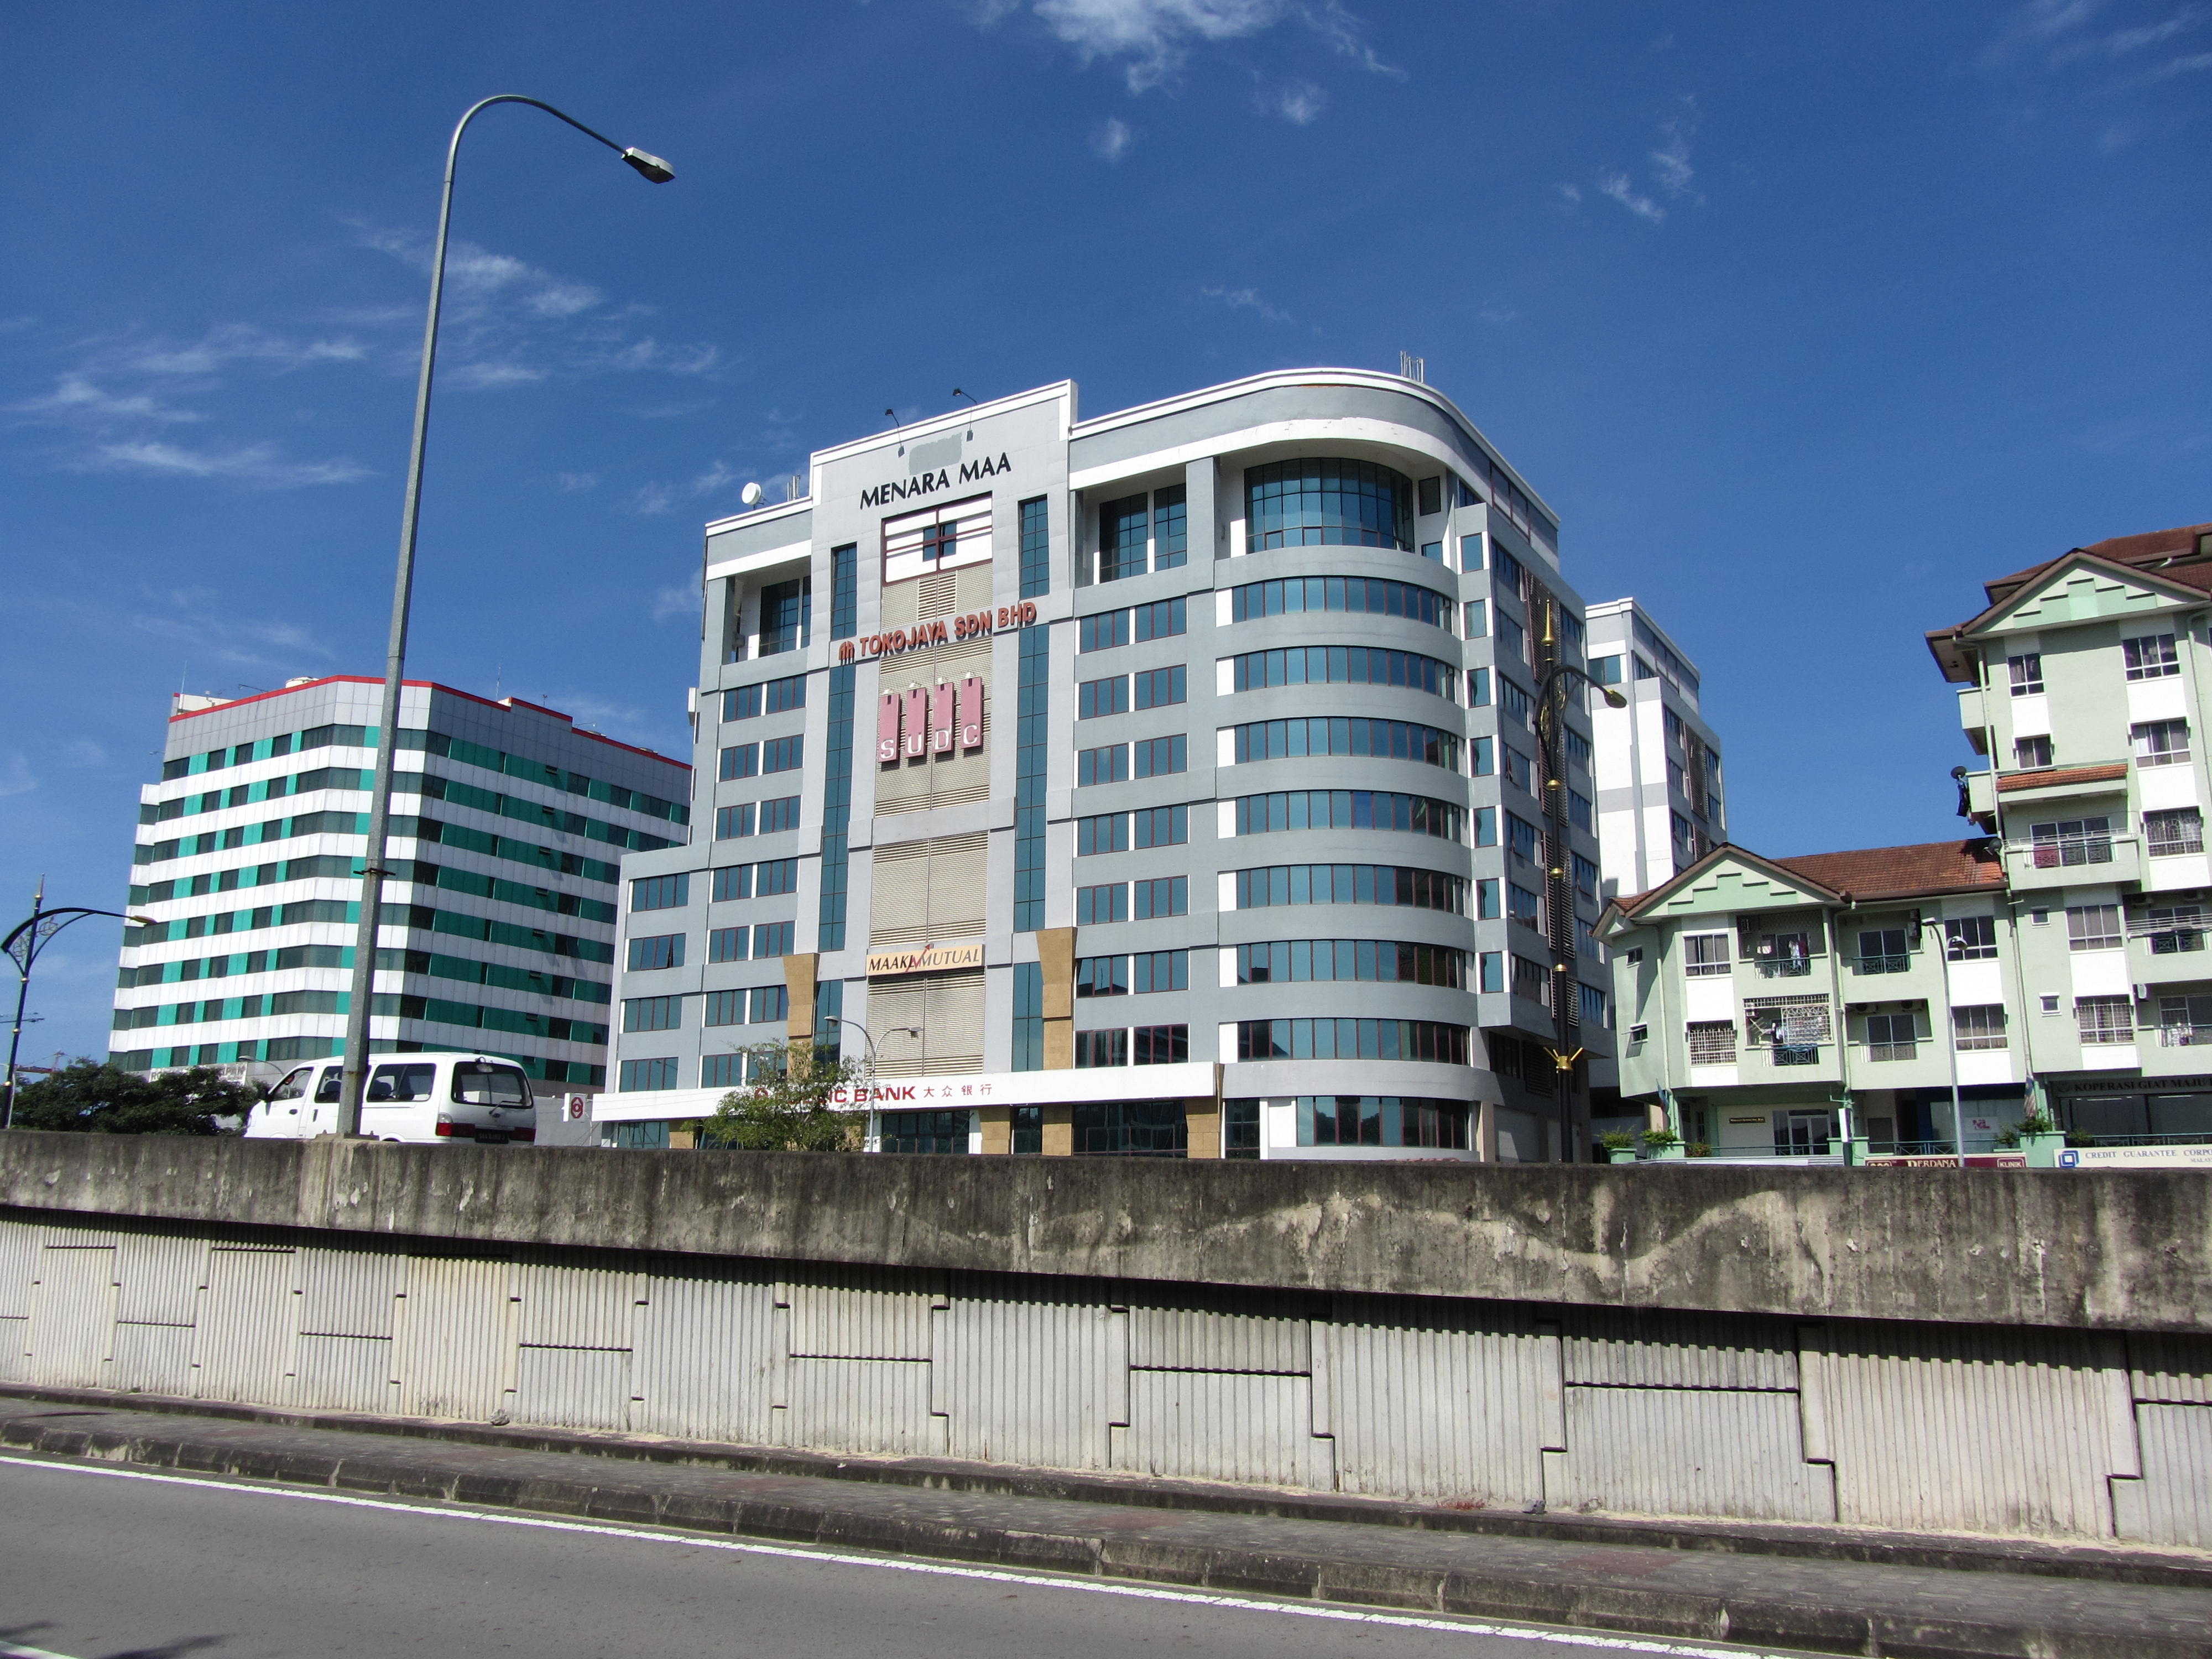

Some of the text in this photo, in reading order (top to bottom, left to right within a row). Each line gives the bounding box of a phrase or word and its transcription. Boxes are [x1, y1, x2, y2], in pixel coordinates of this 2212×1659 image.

[860, 452, 1011, 509] MENARA MAA
[859, 601, 1036, 656] TOKOJAYA SDN BHD
[880, 723, 978, 759] SUDC
[919, 948, 979, 967] MUTUAL
[854, 1086, 916, 1102] BANK
[924, 1084, 992, 1098] 大众银行
[2074, 1081, 2134, 1092] KOPERASI
[2138, 1079, 2168, 1089] GIAT
[2085, 1151, 2117, 1159] CREDIT
[2124, 1149, 2177, 1157] GUARANTEE
